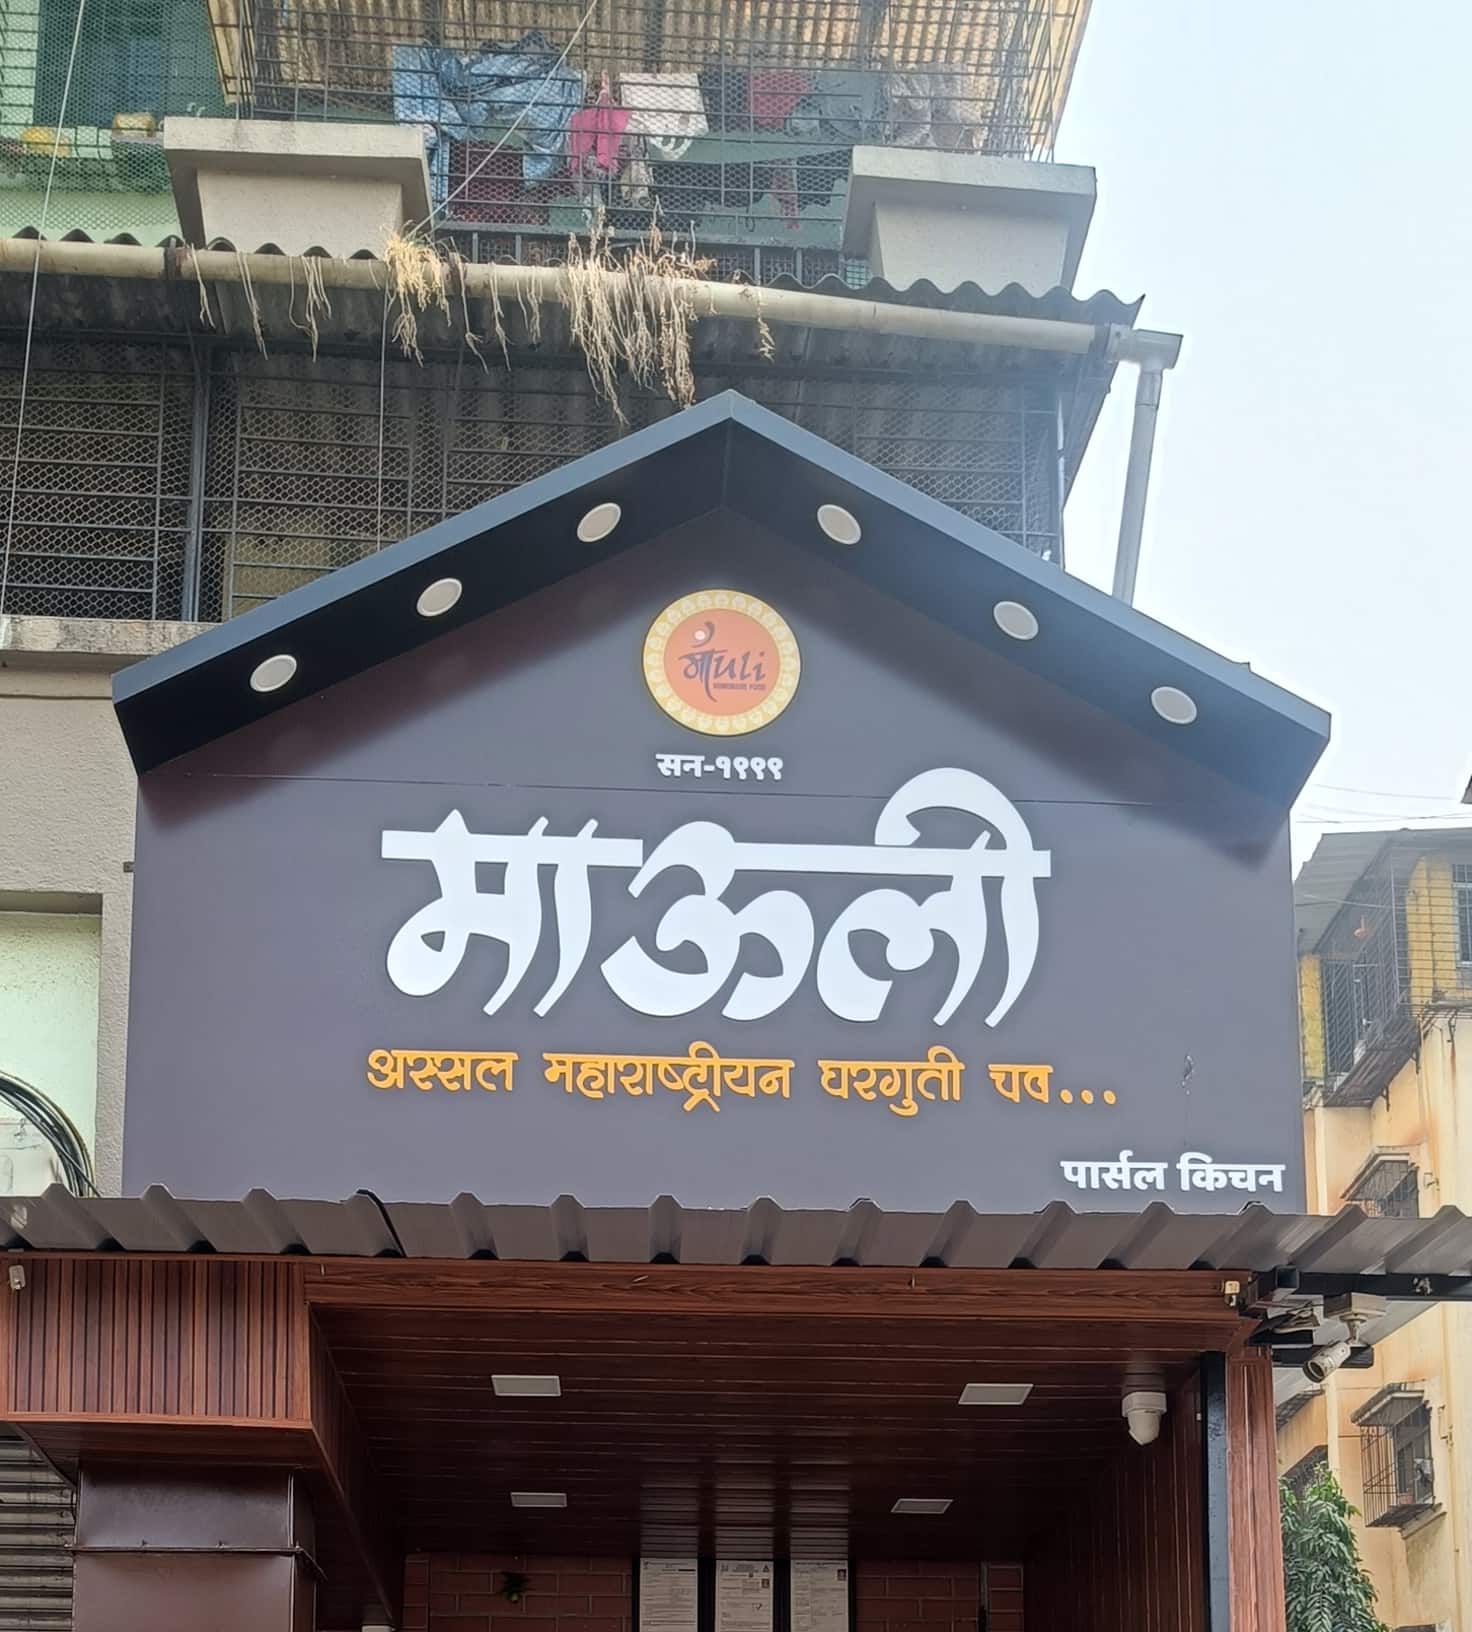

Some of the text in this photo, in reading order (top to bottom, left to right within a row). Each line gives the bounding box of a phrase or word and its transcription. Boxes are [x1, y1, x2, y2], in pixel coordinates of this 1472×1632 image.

[656, 753, 784, 780] सन-१९९९
[382, 767, 1051, 1028] माऊली
[367, 1049, 518, 1091] अस्सल
[542, 1040, 795, 1112] महाराष्ट्रीयन
[817, 1045, 965, 1116] घरगुती
[1060, 1150, 1286, 1192] पार्सल किचन
